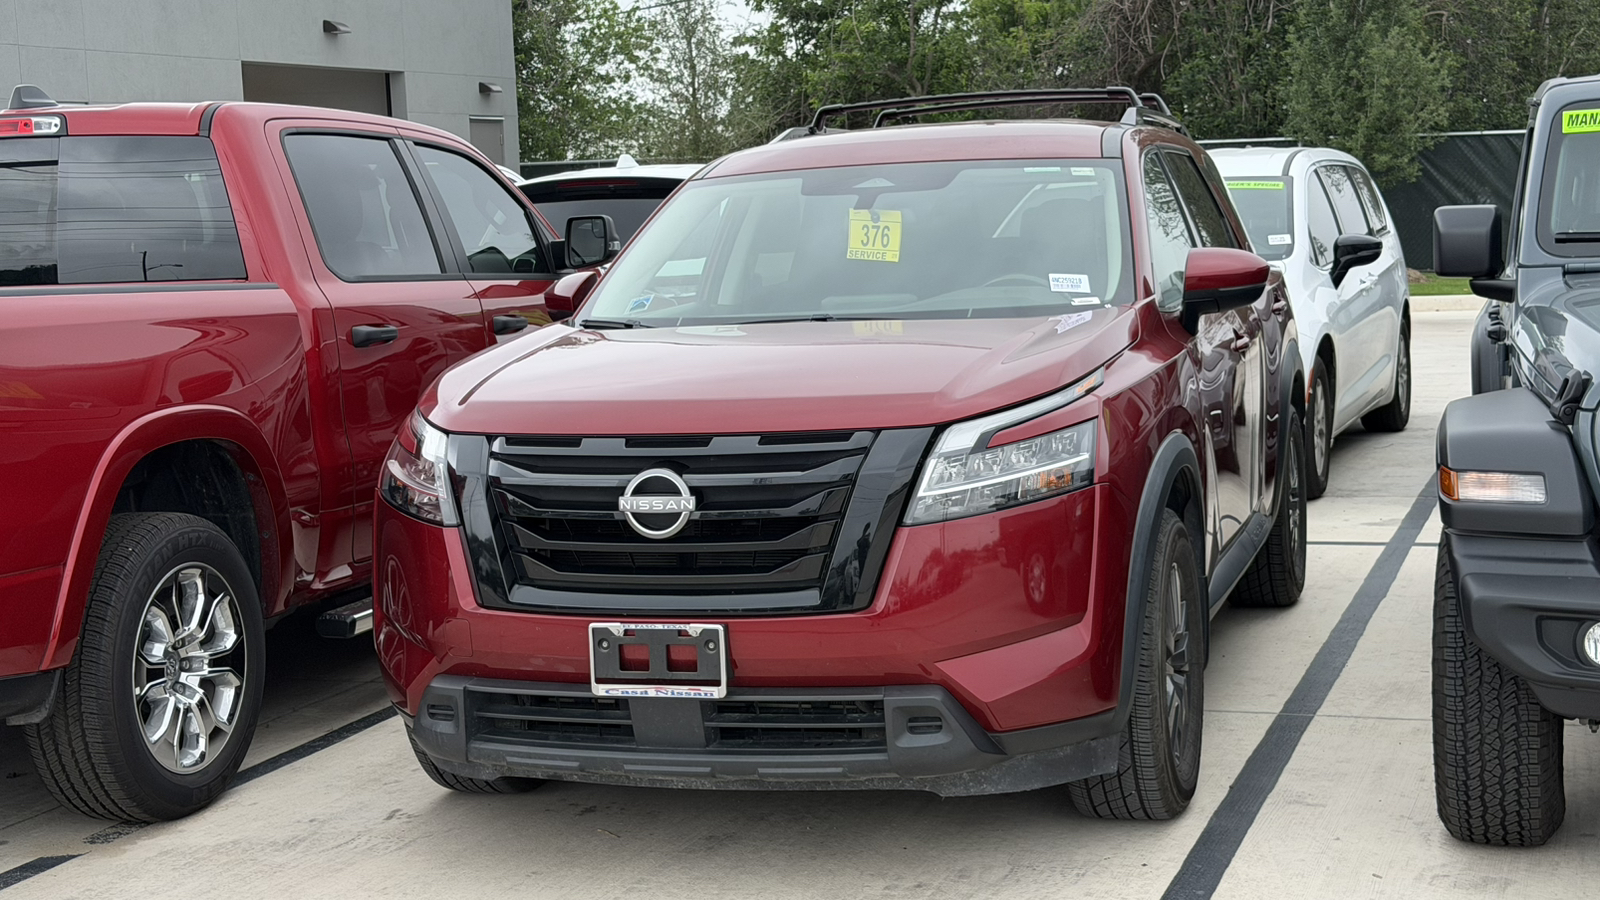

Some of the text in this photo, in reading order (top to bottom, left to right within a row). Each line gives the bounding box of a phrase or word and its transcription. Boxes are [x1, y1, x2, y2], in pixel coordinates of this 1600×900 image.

[1567, 112, 1600, 126] MAN
[860, 224, 891, 248] 376
[848, 249, 888, 260] SERVICE
[620, 499, 693, 510] NISSAN
[605, 688, 716, 697] Casa Nissan
